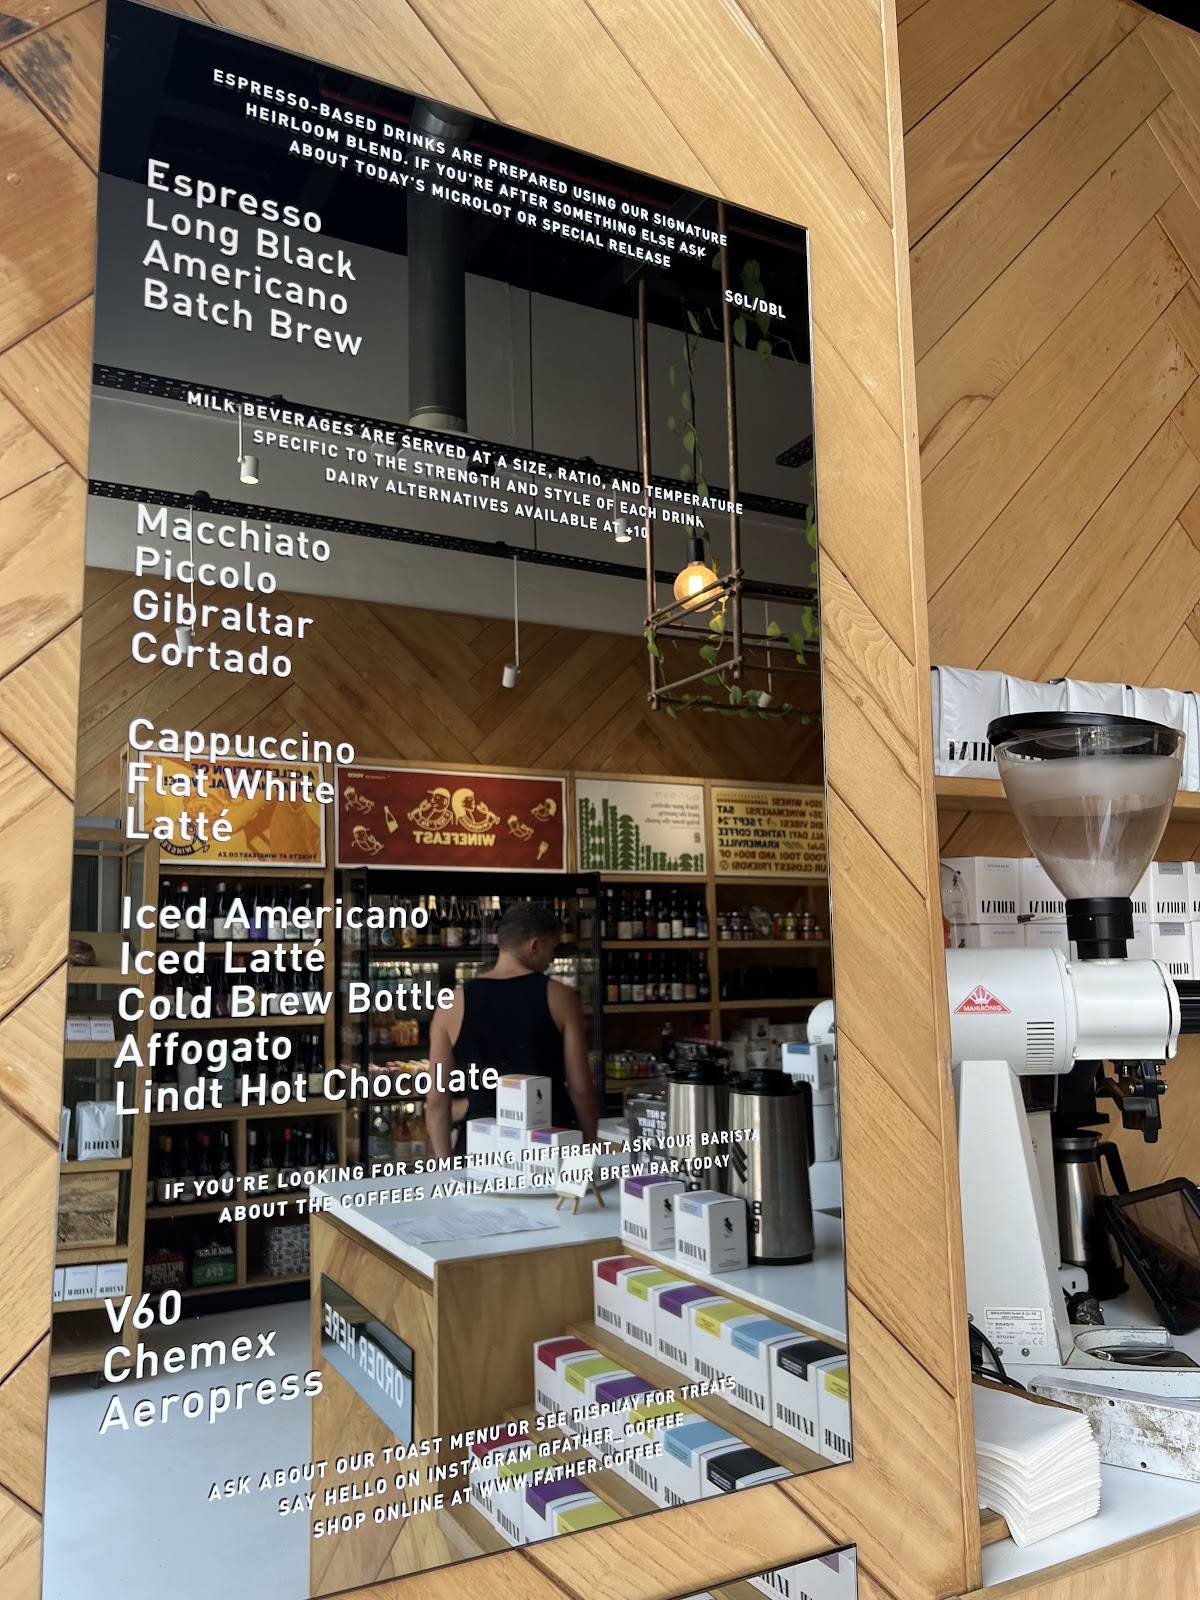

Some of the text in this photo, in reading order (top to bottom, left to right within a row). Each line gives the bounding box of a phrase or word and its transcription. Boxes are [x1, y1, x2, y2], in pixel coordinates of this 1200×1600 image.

[213, 69, 727, 247] ESPRESSO-BASED DRINKS ARE PREPARED USING OUR SIGNATURE
[246, 102, 706, 258] HEIRLOOM BLEND. IF YOU'RE AFTER SOMETHING ELSE ASK
[147, 158, 322, 233] Espresso
[289, 140, 671, 267] ABOUT TODAY'S MICROLOT OR SPECIAL RELEASE
[146, 198, 357, 281] Long Black
[142, 239, 349, 316] Americano
[724, 289, 787, 319] SGL/DBL
[144, 277, 363, 356] Batch Brew
[187, 390, 744, 515] MILK BEVERAGES ARE SERVED AT A SIZE, RATIO, AND TEMPERATURE
[253, 430, 705, 528] SPECIFIC TO THE STRENGTH AND STYLE OF EACH DRINK
[136, 504, 331, 562] Macchiato
[325, 467, 379, 490] DAIRY
[385, 479, 509, 514] ALTERNATIVES
[514, 503, 598, 531] AVAILABLE
[603, 519, 620, 534] AT
[135, 545, 277, 594] Piccolo
[132, 588, 314, 639] Gibraltar
[130, 632, 292, 679] Cortado
[128, 718, 356, 765] Cappuccino
[127, 761, 335, 804] Flat White
[125, 806, 233, 842] Latté
[122, 895, 429, 930] Iced Americano
[120, 938, 326, 975] Iced Latté
[117, 980, 455, 1022] Cold Brew Bottle
[114, 1030, 293, 1073] Affogato
[115, 1062, 500, 1116] Lindt Hot Chocolate
[164, 1183, 185, 1200] IF
[277, 1165, 364, 1189] LOOKING
[371, 1161, 407, 1180] FOR
[414, 1150, 516, 1175] SOMETHING
[521, 1141, 616, 1163] DIFFERENT,
[621, 1138, 651, 1154] ASK
[657, 1134, 695, 1150] YOUR
[701, 1127, 760, 1145] BARISTA
[218, 1200, 287, 1224] ABOUT
[295, 1197, 333, 1215] THE
[341, 1188, 425, 1210] COFFEES
[430, 1172, 527, 1200] AVAILABLE
[532, 1171, 555, 1188] ON
[560, 1168, 595, 1185] OUR
[600, 1163, 645, 1181] BREW
[650, 1159, 680, 1176] BAR
[684, 1153, 730, 1172] TODAY
[104, 1289, 182, 1334] V60
[103, 1331, 277, 1383] Chemex
[99, 1369, 324, 1434] Aeropress
[207, 1476, 251, 1502] ASK
[259, 1461, 329, 1492] ABOUT
[335, 1451, 376, 1474] OUR
[383, 1437, 444, 1463] TOAST
[449, 1427, 501, 1450] MENU
[507, 1420, 529, 1438] OR
[535, 1413, 568, 1432] SEE
[572, 1396, 641, 1425] DISPLAY
[645, 1390, 675, 1410] FOR
[680, 1376, 737, 1400] TREATS
[278, 1412, 684, 1517] SAY HELLO ON INSTAGRAM @FATHER_COFFEE
[313, 1511, 366, 1539] SHOP
[373, 1493, 445, 1524] ONLINE
[451, 1487, 473, 1505] AT
[479, 1441, 664, 1499] WWW.FATHER.COFFEE
